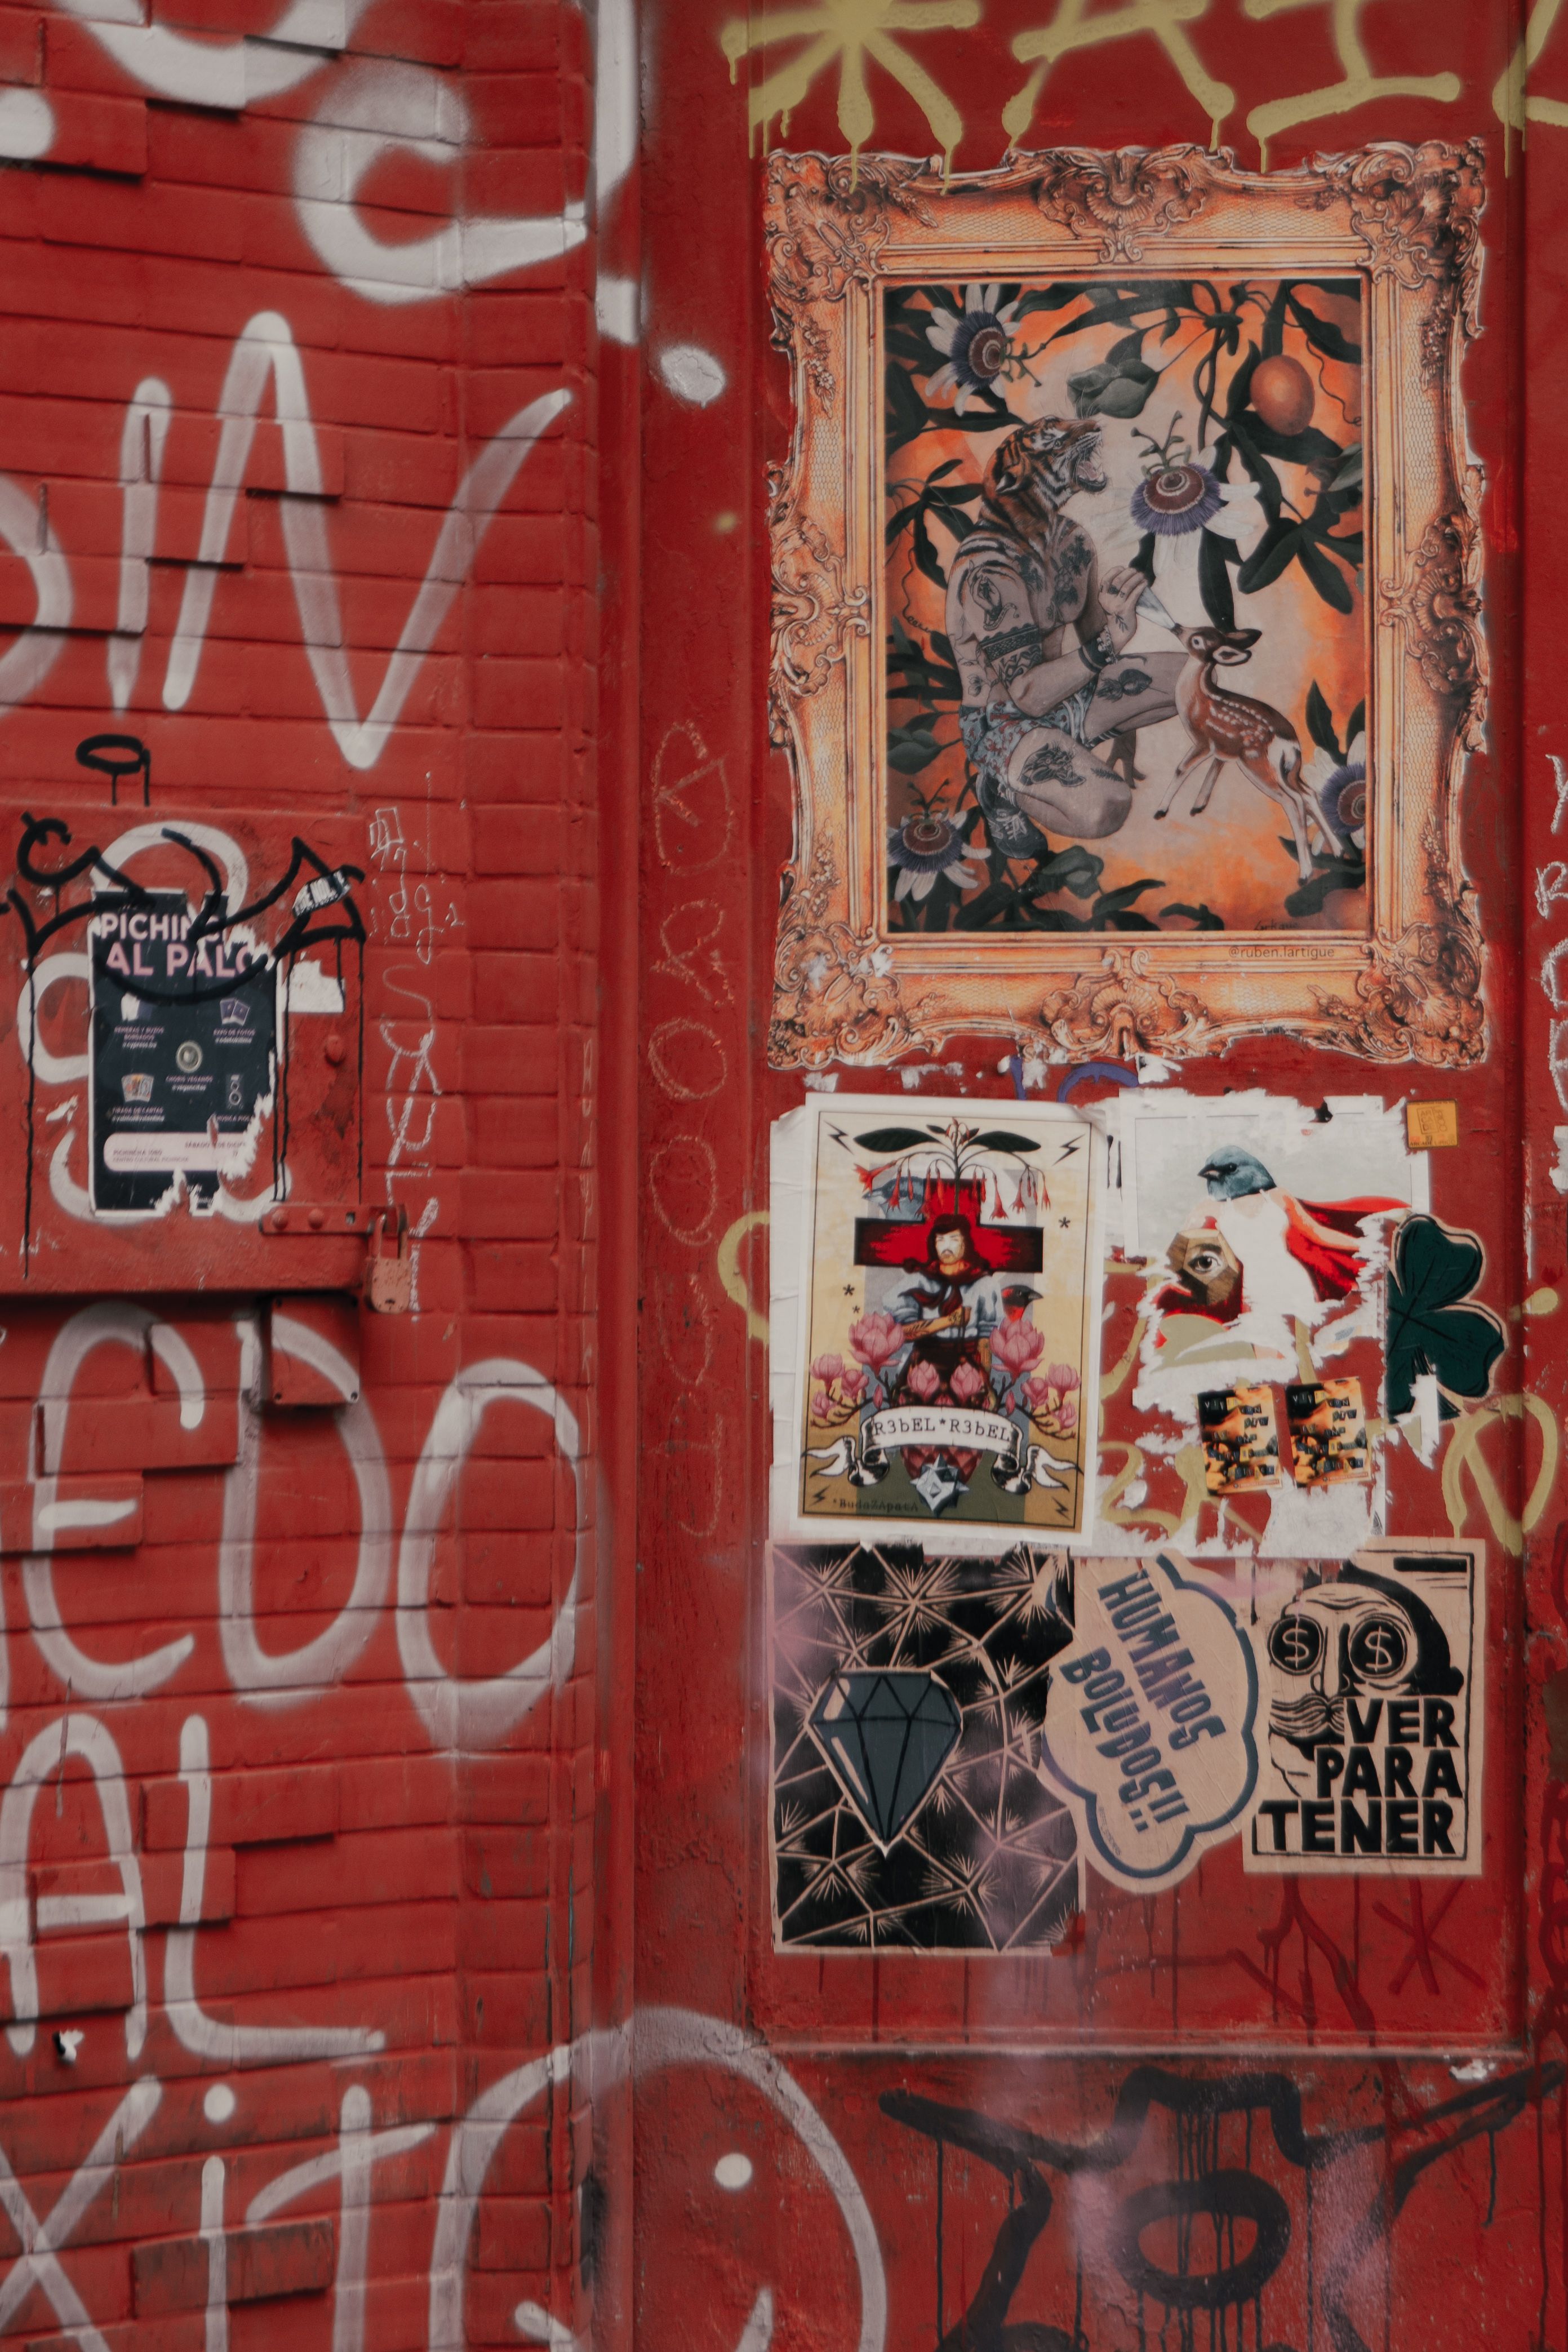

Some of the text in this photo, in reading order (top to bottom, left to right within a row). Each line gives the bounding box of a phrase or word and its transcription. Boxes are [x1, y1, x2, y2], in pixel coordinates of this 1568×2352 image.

[106, 942, 154, 975] AL
[1229, 946, 1334, 960] @ruben.lartigue
[1098, 1568, 1227, 1751] HUMANOS
[1346, 1697, 1461, 1748] VER
[1317, 1745, 1463, 1798] PARA
[1258, 1800, 1456, 1854] TENER
